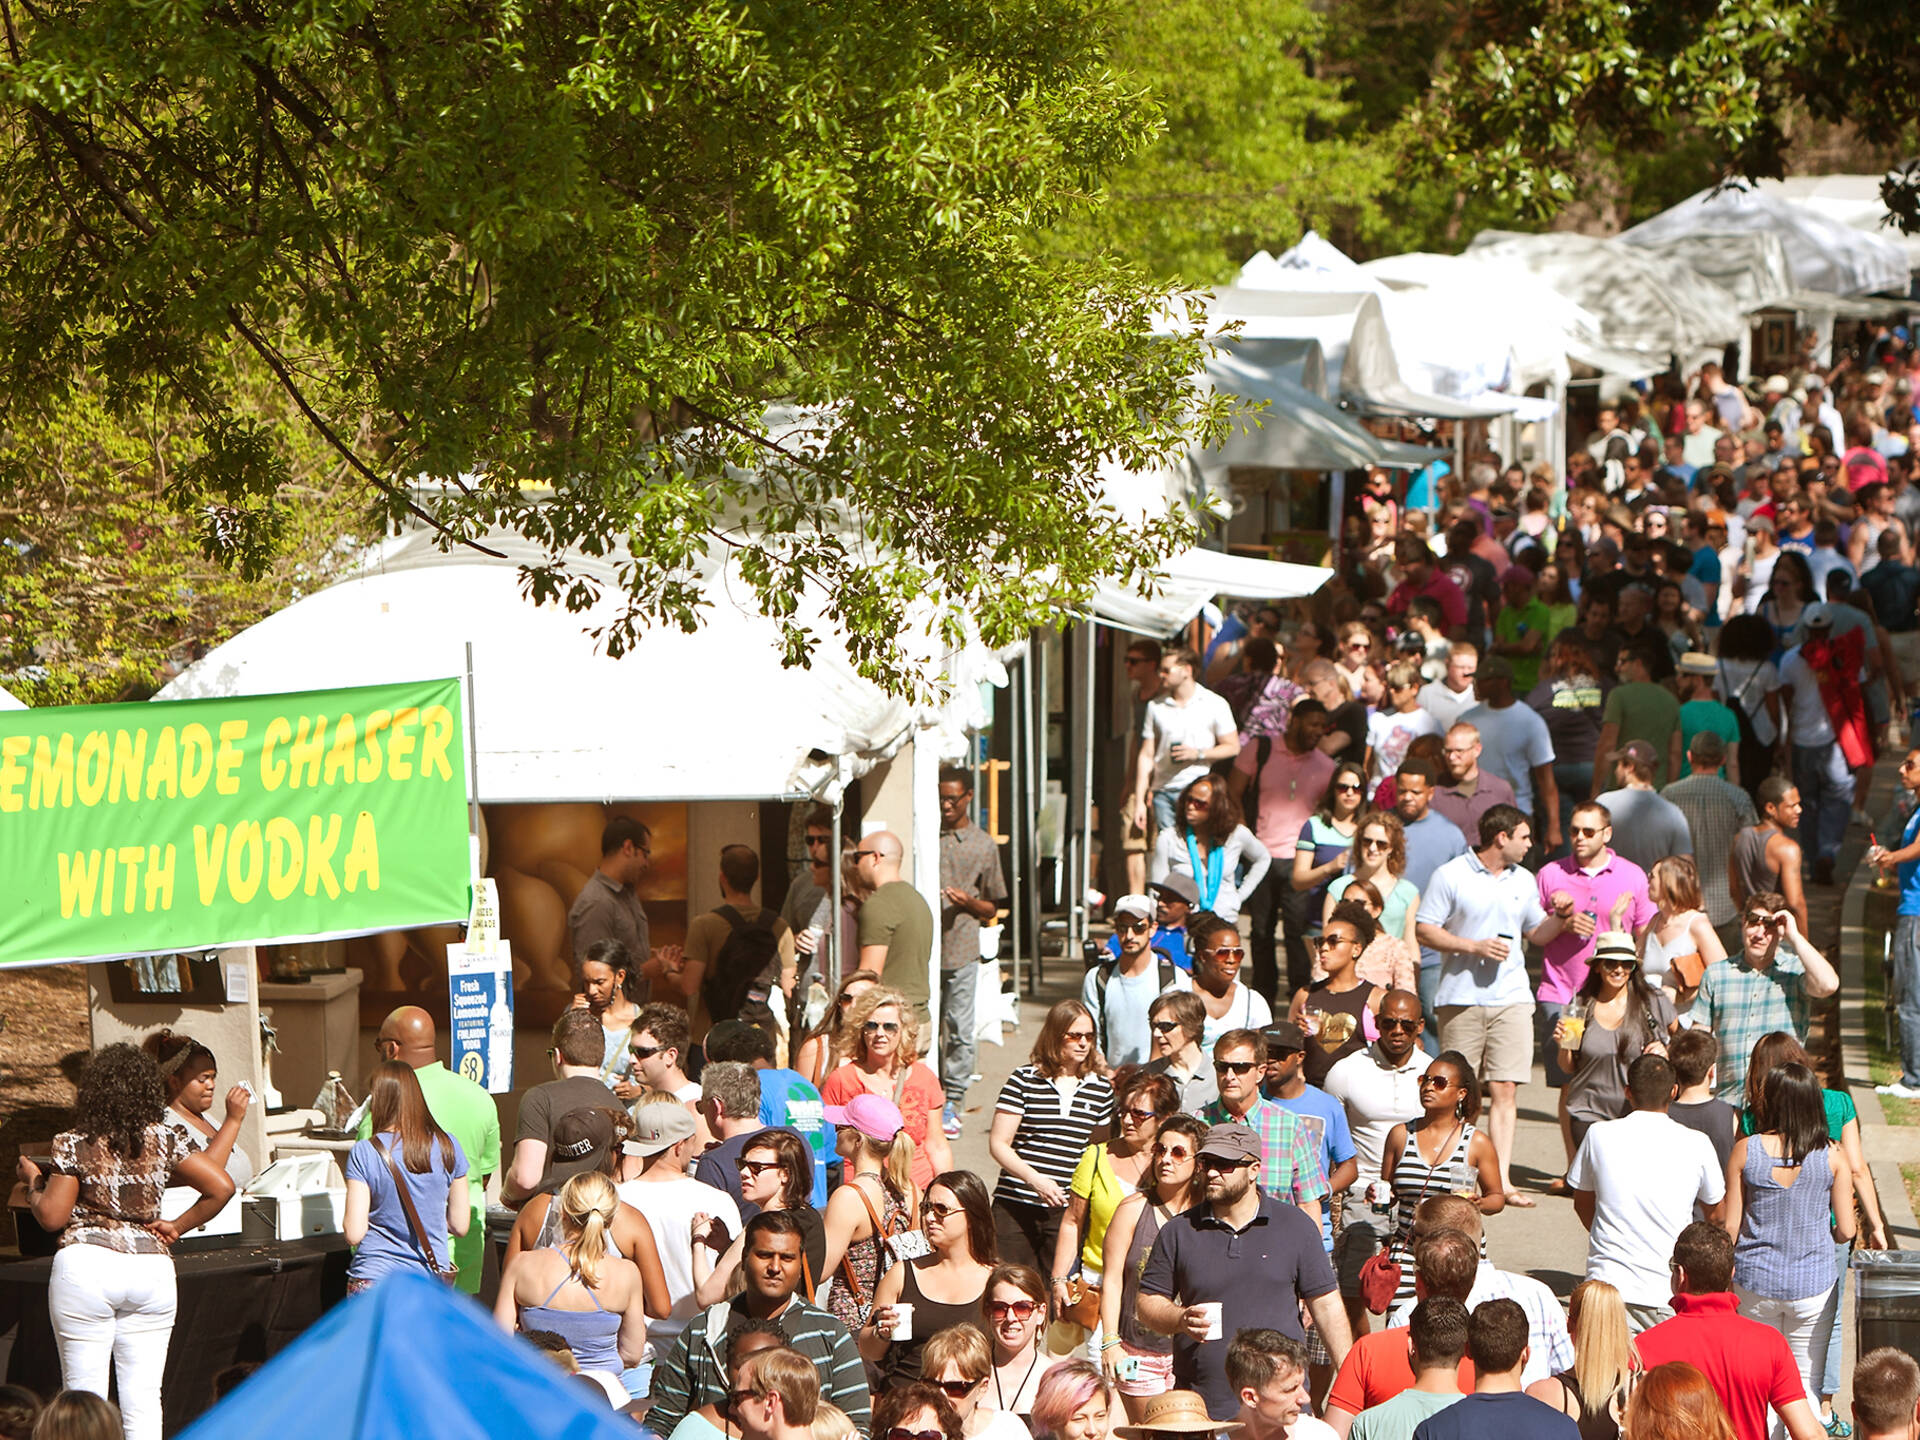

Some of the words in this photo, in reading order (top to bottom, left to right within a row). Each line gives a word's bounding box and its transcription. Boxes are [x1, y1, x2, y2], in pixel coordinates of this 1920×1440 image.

[260, 705, 454, 792] CHASER
[58, 843, 176, 919] WITH
[193, 811, 380, 906] VODKA
[460, 980, 480, 992] Fresh
[454, 992, 487, 1008] Squeezed
[454, 1005, 489, 1019] Lemonade
[464, 1057, 477, 1084] $8
